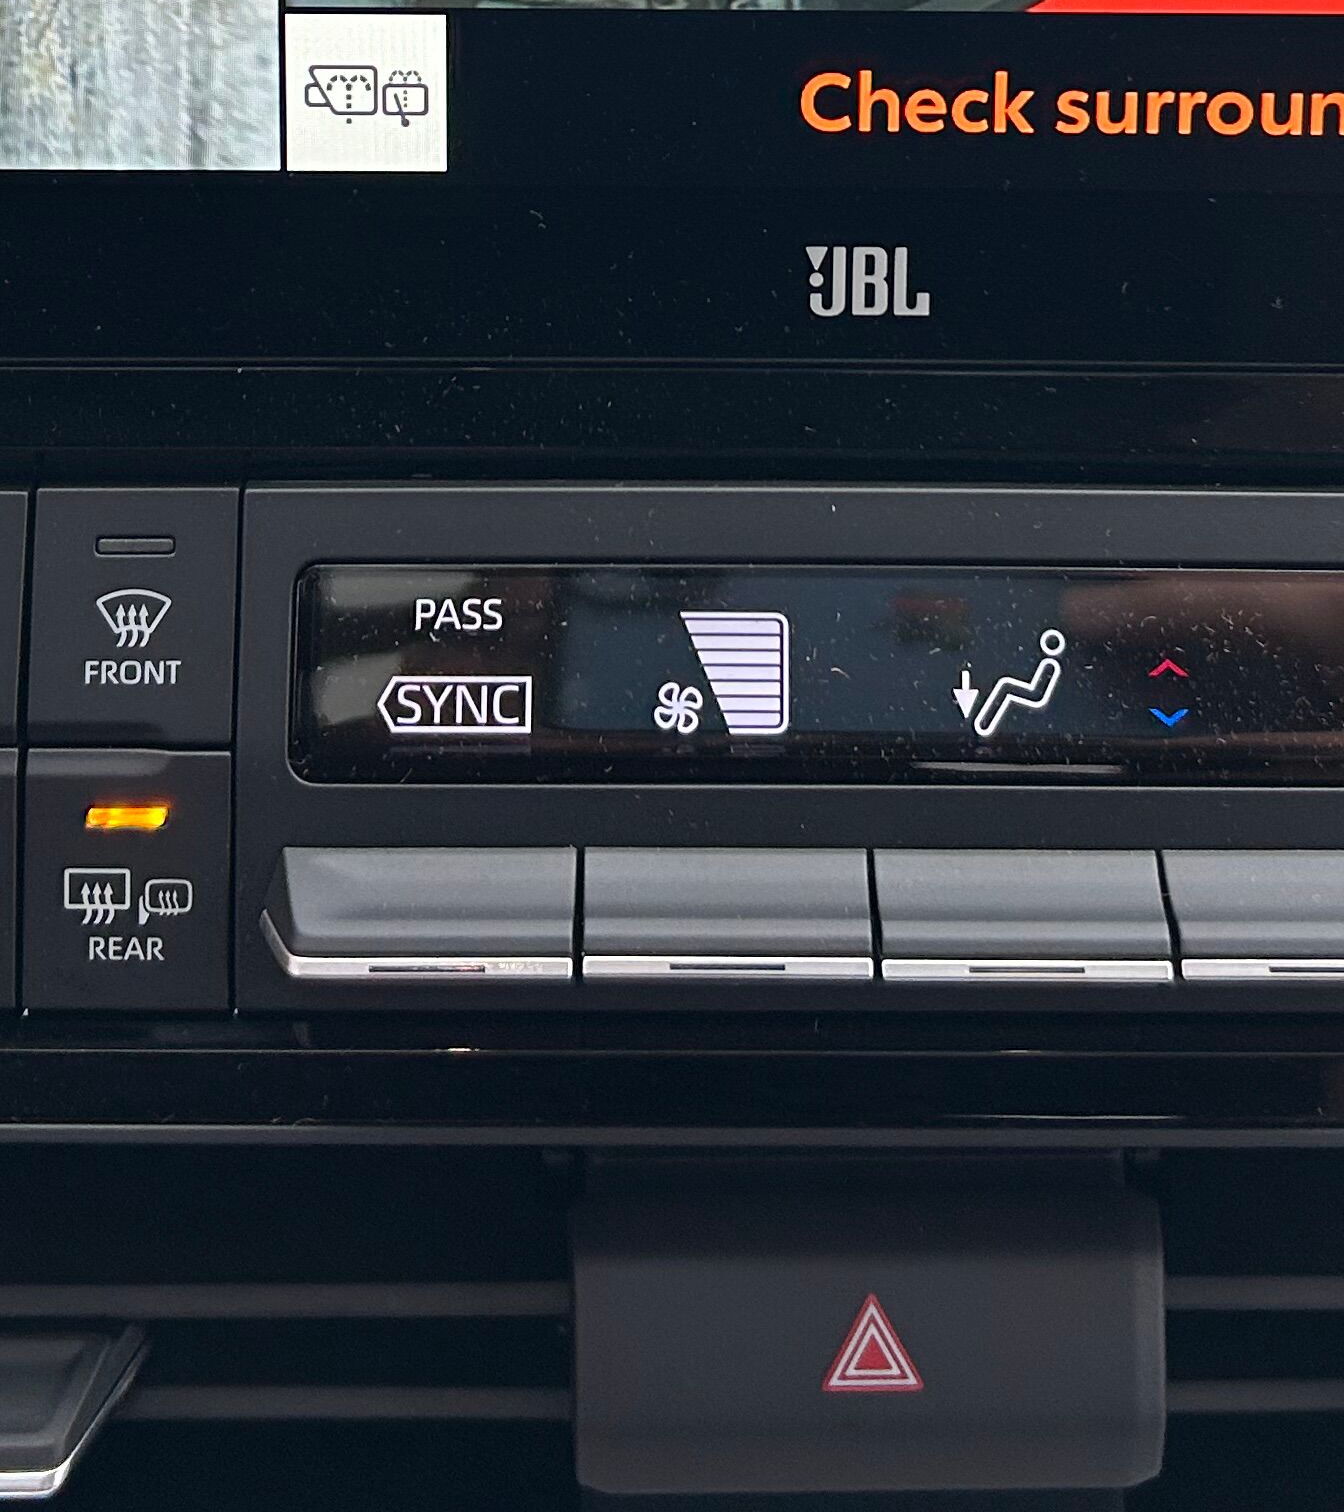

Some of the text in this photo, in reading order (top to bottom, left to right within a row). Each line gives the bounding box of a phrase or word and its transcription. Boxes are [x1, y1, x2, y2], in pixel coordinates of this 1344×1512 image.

[800, 69, 1035, 134] Check
[806, 246, 930, 317] JBL
[413, 597, 504, 631] PASS
[84, 660, 182, 685] FRONT
[396, 684, 520, 725] SYNC
[88, 936, 165, 961] REAR
